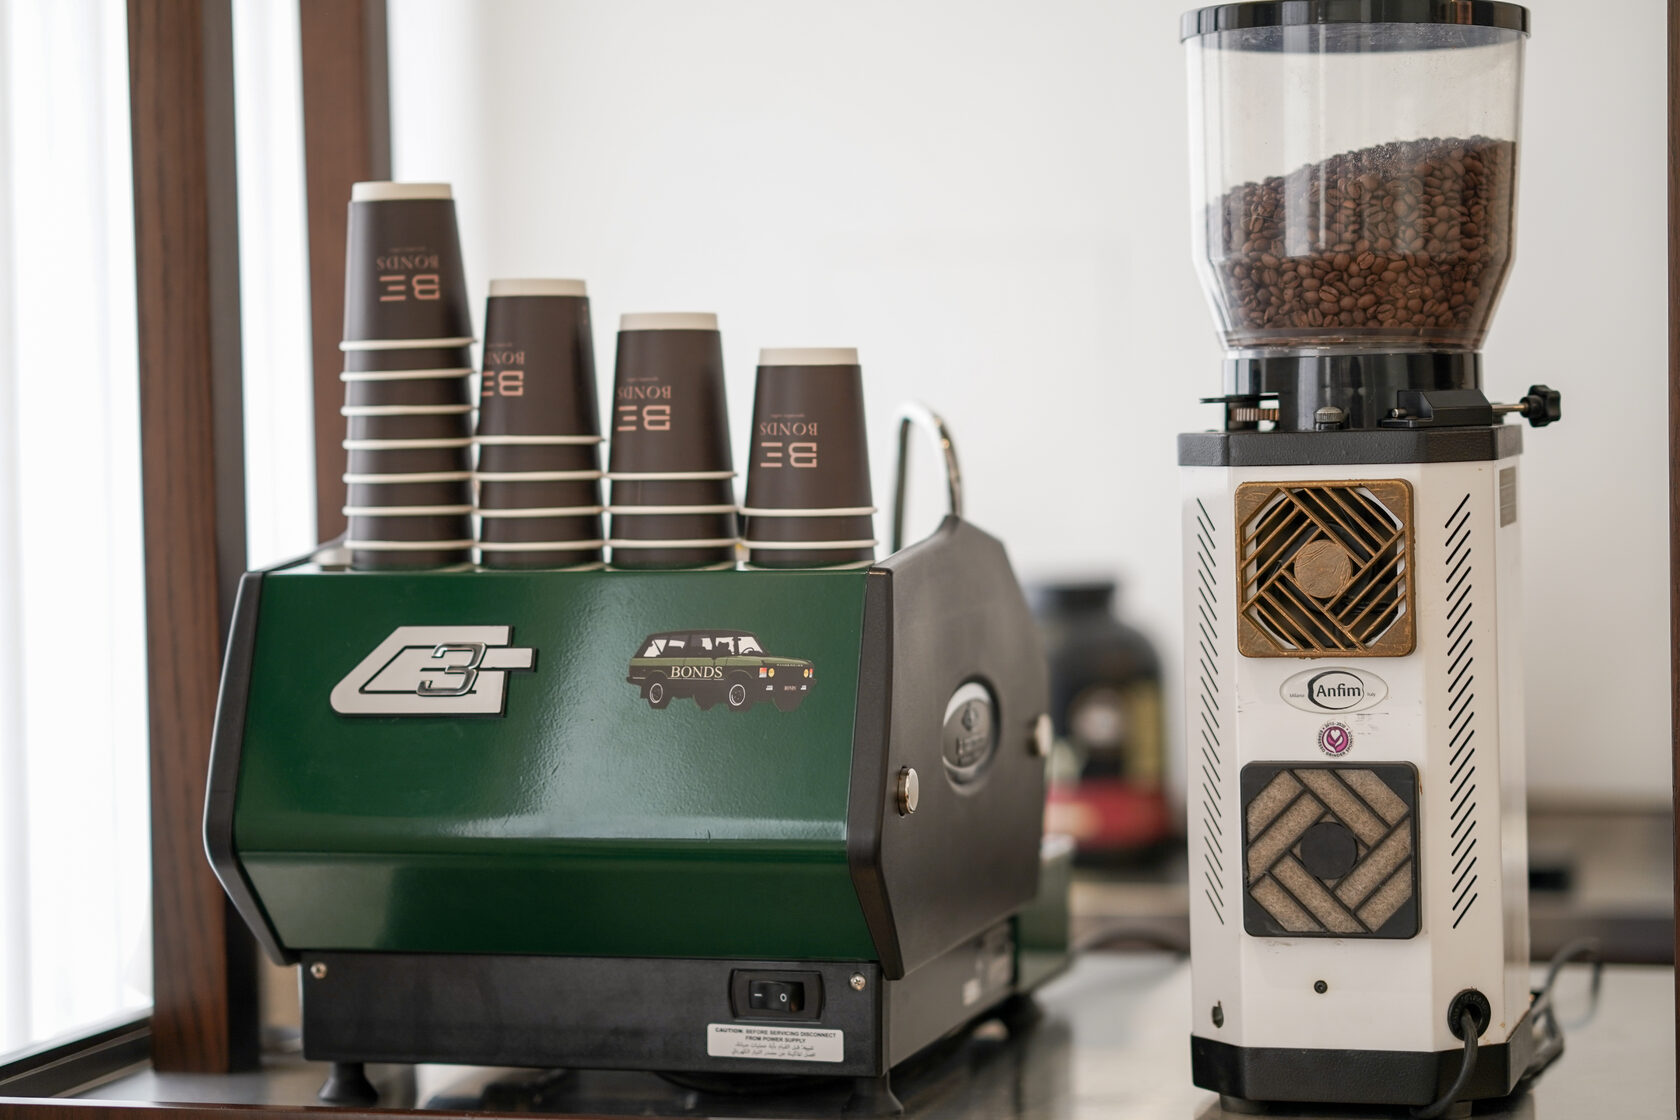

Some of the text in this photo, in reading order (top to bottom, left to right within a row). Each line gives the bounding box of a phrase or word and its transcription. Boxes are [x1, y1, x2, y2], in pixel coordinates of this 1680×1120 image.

[377, 255, 440, 271] BONDS
[616, 385, 672, 399] BONDS
[759, 422, 818, 436] BONDS
[671, 666, 723, 678] BONDS
[1316, 683, 1361, 697] Anfim
